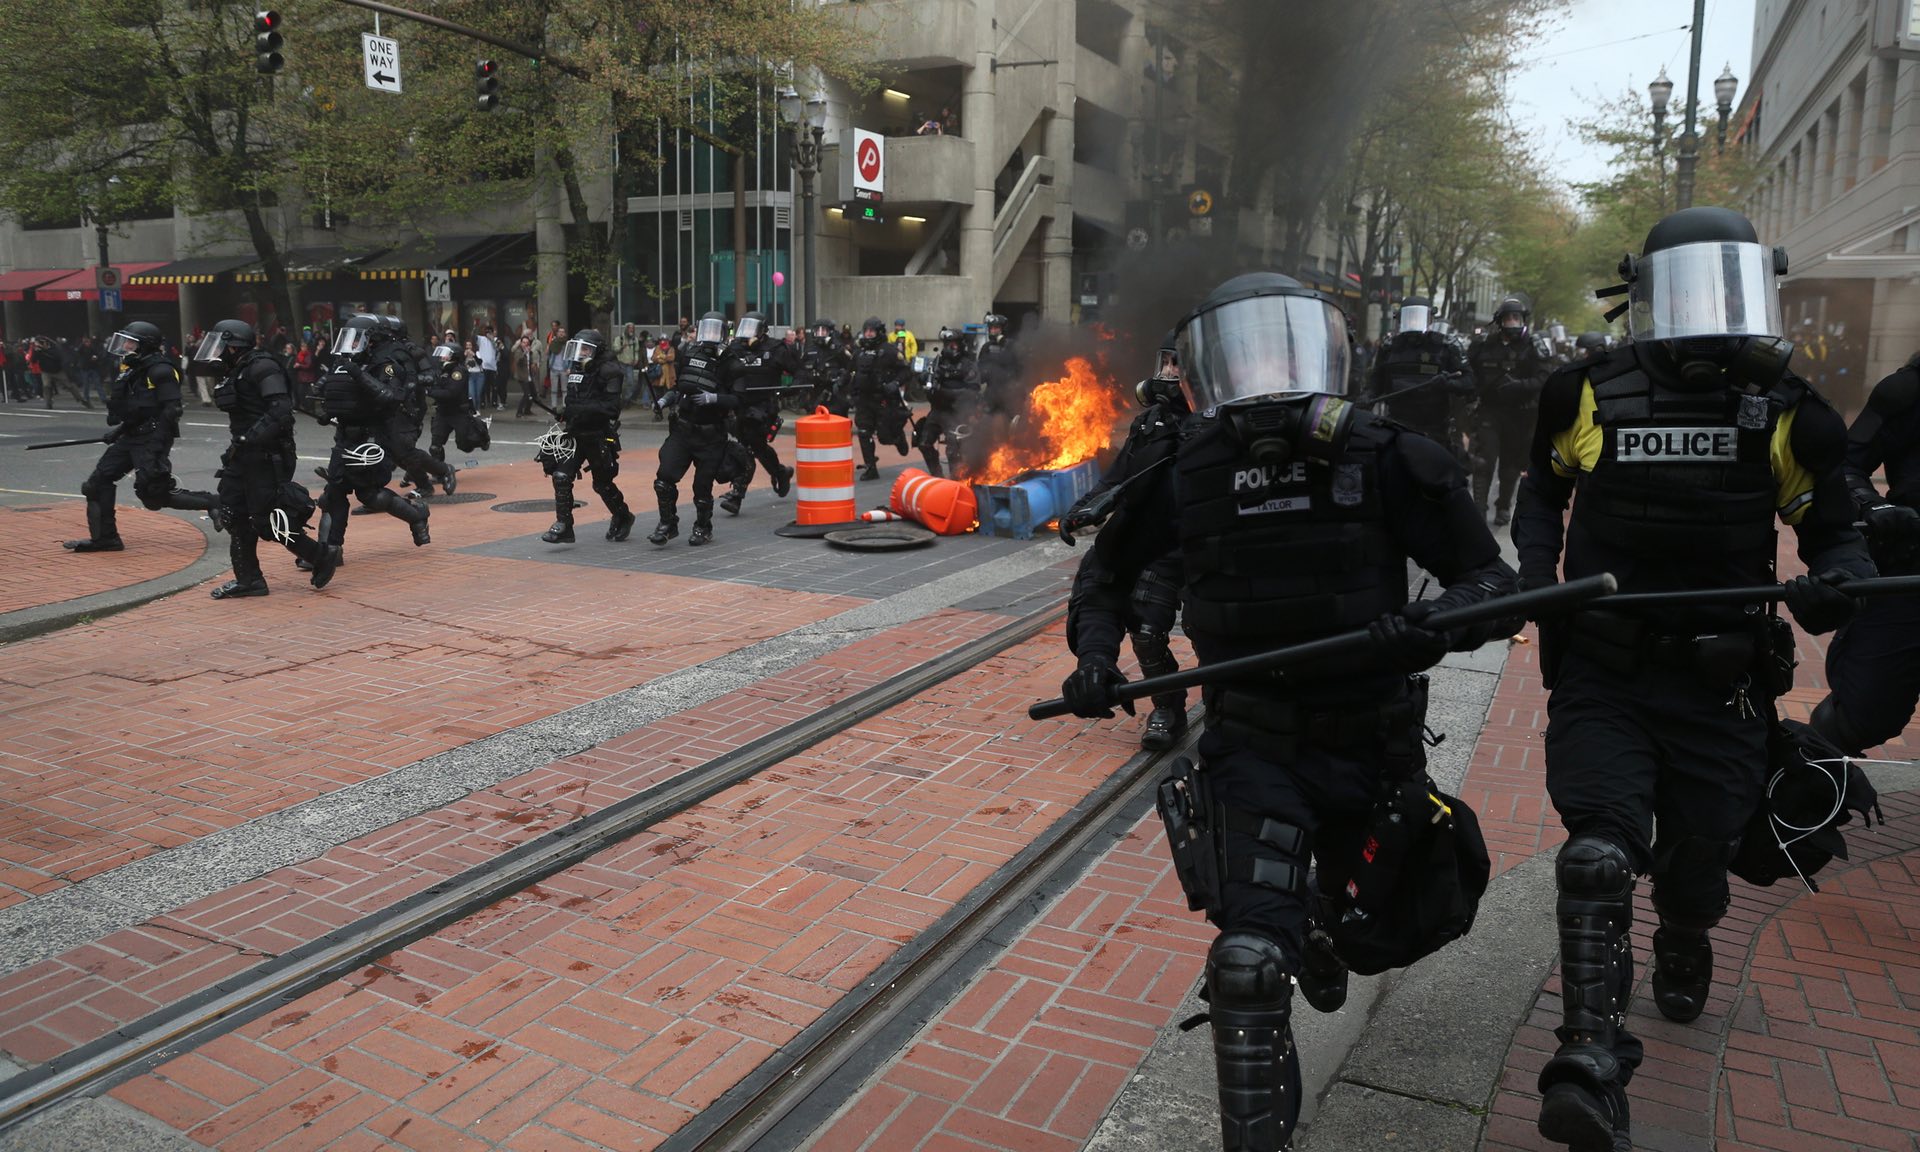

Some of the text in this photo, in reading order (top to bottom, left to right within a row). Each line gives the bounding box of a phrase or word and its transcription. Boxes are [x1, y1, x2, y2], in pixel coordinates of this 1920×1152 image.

[370, 40, 393, 55] ONE
[370, 54, 394, 69] WAY
[861, 147, 877, 170] P
[690, 360, 706, 369] POLICE
[1624, 432, 1730, 457] POLICE
